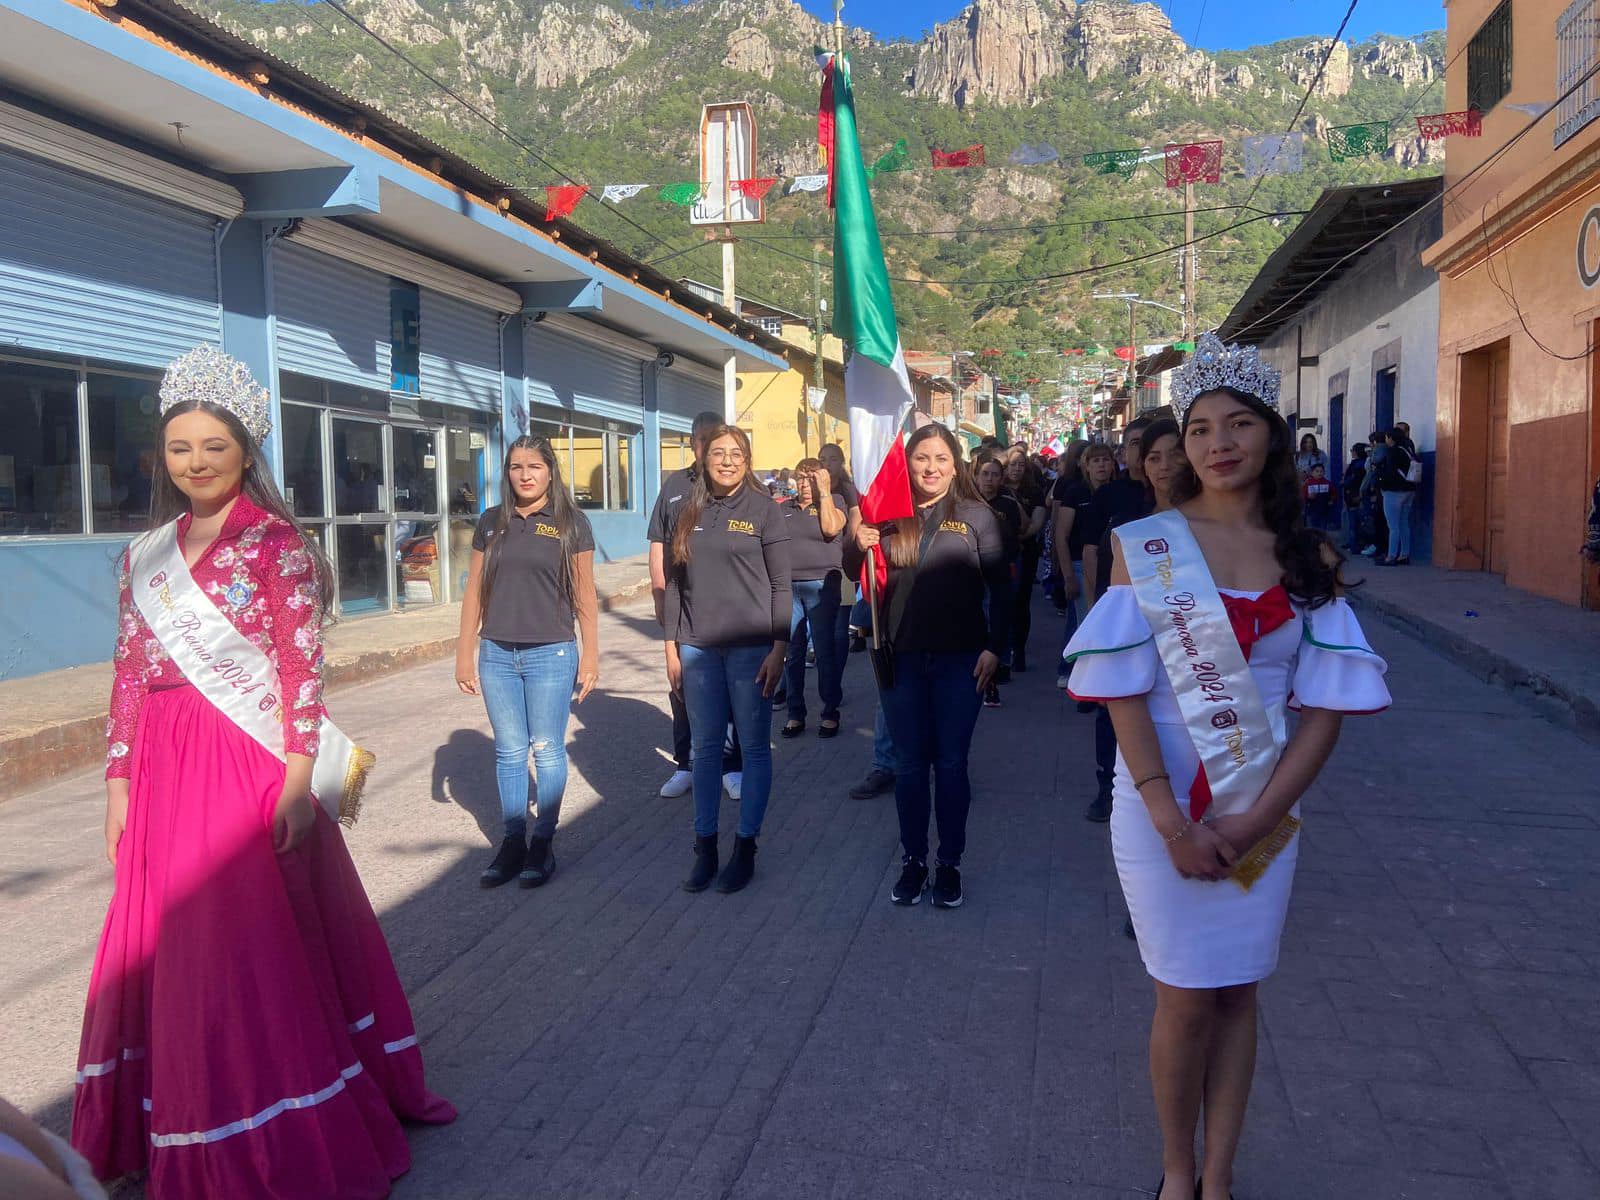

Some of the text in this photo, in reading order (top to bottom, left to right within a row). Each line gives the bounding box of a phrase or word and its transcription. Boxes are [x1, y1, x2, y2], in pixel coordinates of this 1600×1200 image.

[728, 520, 754, 531] TOPIA
[172, 611, 265, 695] Reina 2024
[1164, 592, 1234, 702] Princesa 2024
